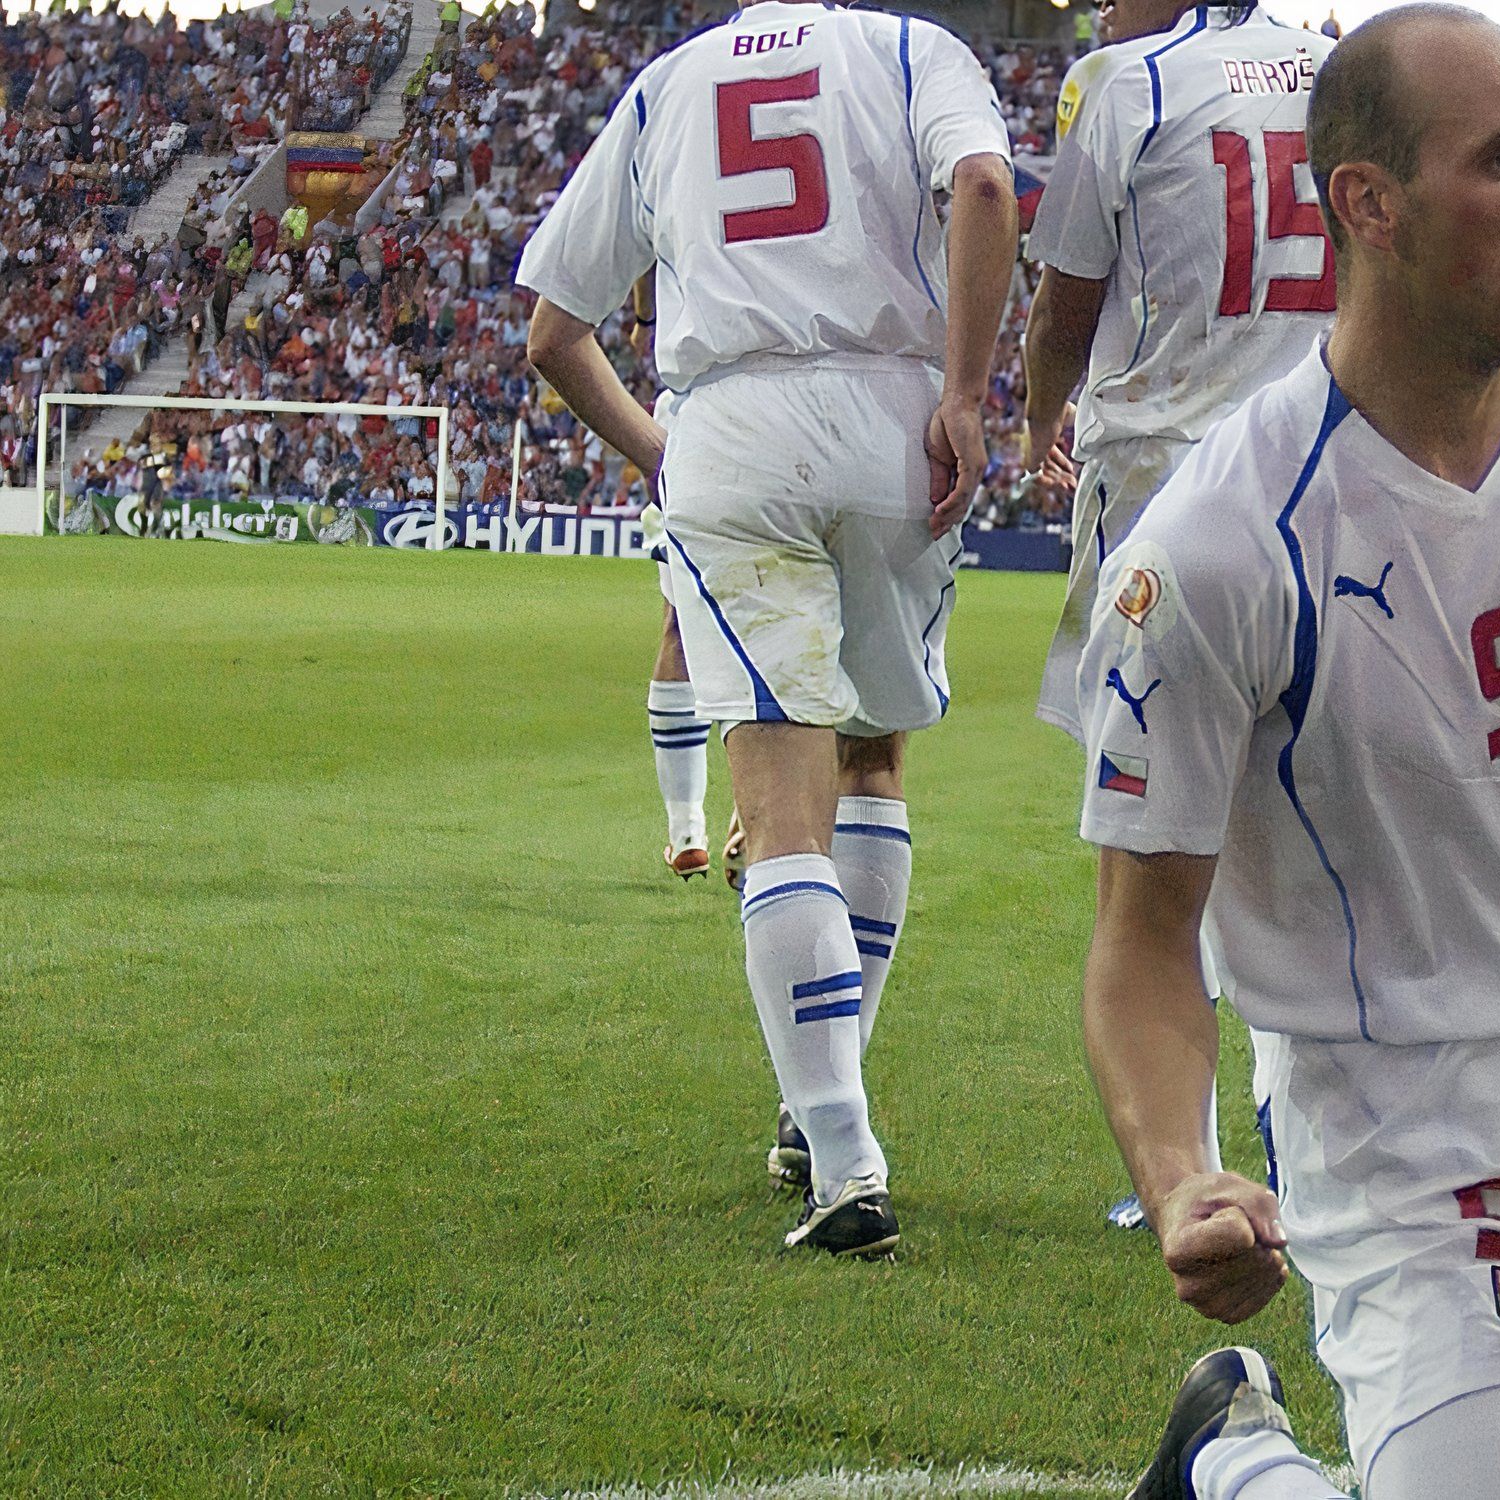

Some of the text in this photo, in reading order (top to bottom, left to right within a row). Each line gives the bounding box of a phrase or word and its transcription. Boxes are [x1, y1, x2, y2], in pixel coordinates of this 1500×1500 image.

[732, 23, 814, 57] BOLF
[715, 66, 829, 244] 5
[1211, 130, 1338, 317] 15
